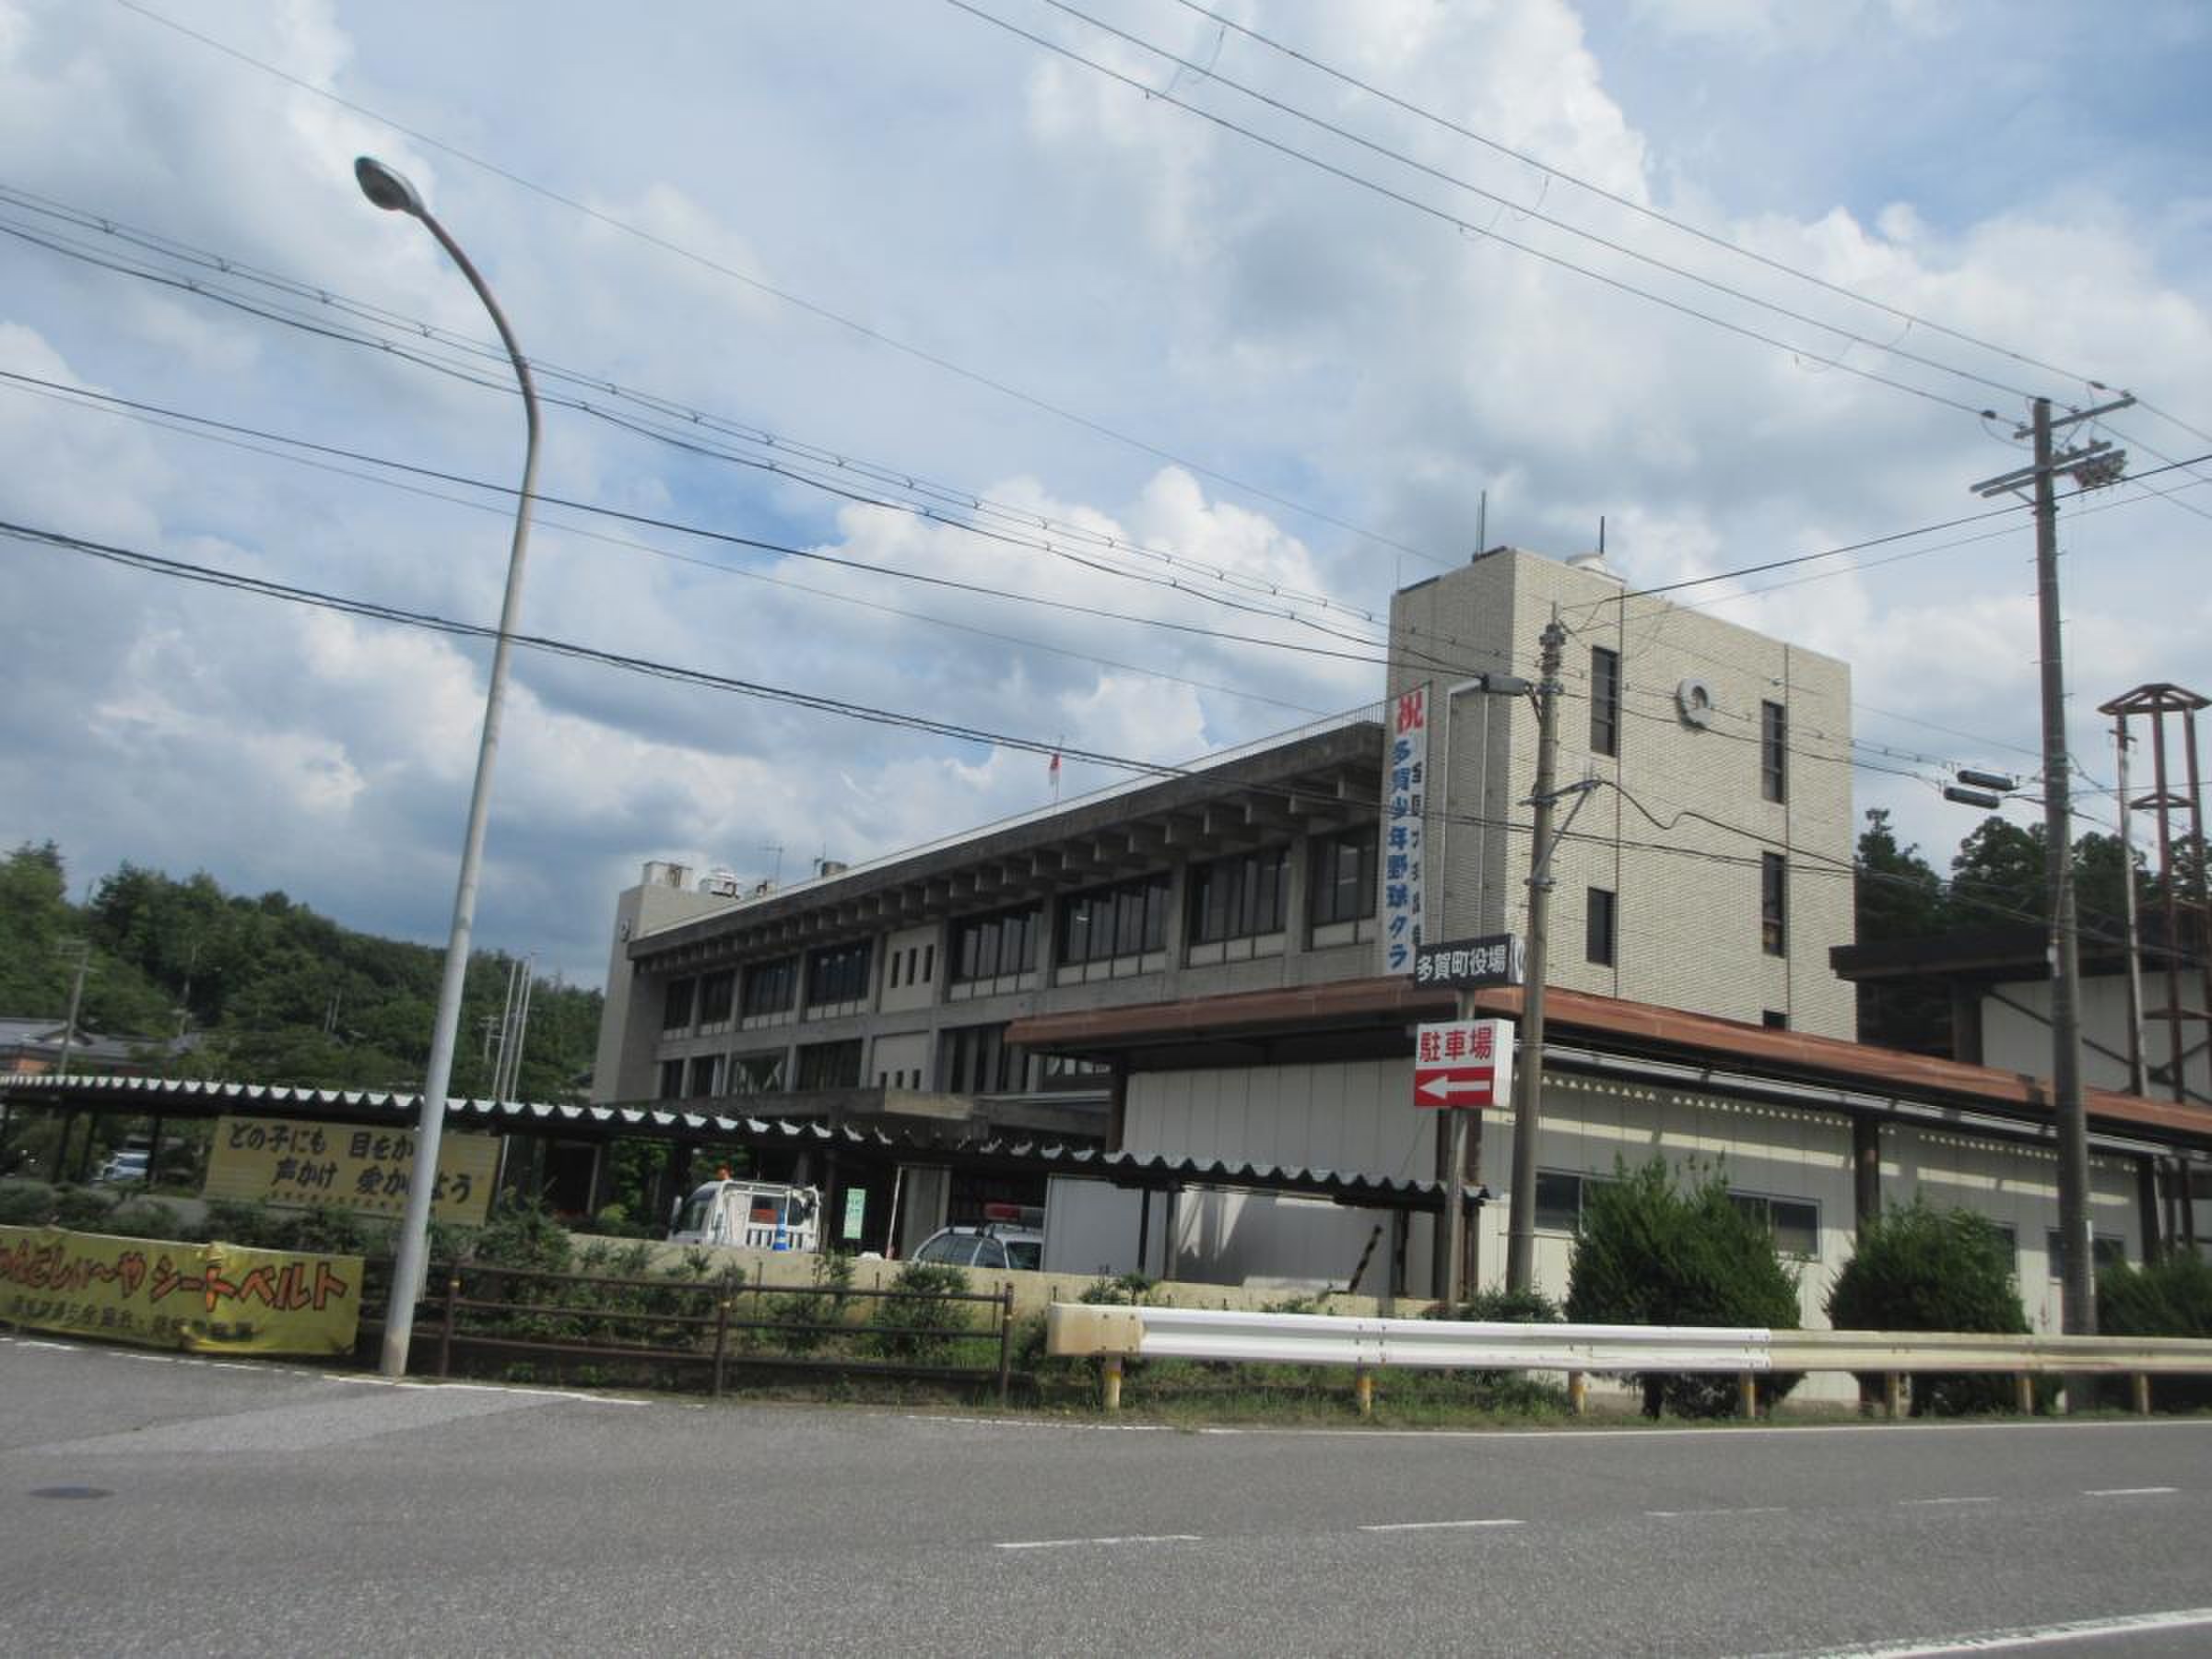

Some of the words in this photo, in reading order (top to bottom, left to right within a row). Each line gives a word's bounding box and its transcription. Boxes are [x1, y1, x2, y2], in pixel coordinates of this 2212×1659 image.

[1394, 689, 1423, 735] 祝
[1417, 945, 1507, 983] 多賀町役場
[1419, 1026, 1493, 1063] 駐車場
[229, 1122, 326, 1156] どの子にも
[348, 1131, 414, 1162] 目をか
[271, 1157, 337, 1189] 声かけ
[354, 1164, 472, 1205] 愛かよう
